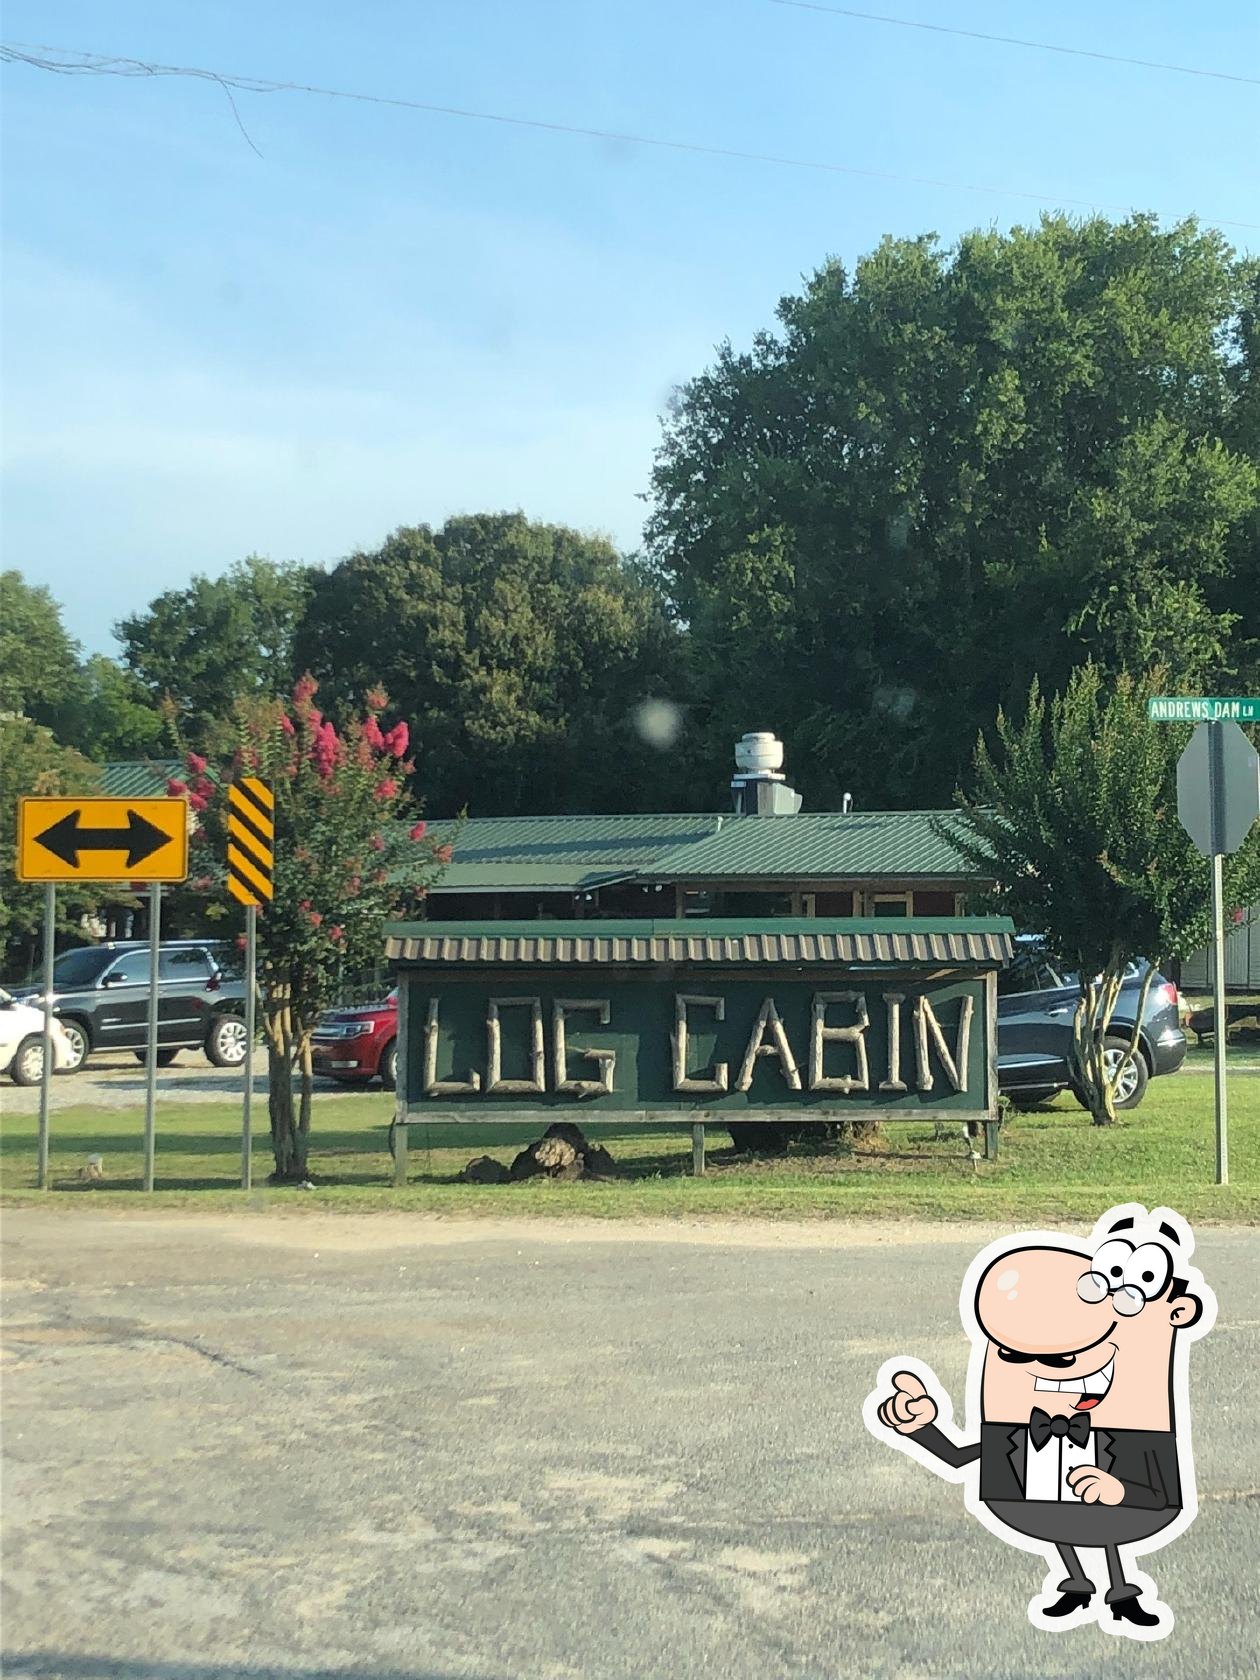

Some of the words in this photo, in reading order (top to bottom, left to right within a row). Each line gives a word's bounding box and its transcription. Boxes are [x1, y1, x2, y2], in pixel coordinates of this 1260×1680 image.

[1151, 701, 1209, 718] ANDREWS
[1214, 702, 1240, 718] DAM
[1242, 705, 1254, 716] LN
[423, 997, 616, 1097] LOG
[670, 991, 974, 1093] CABIN
